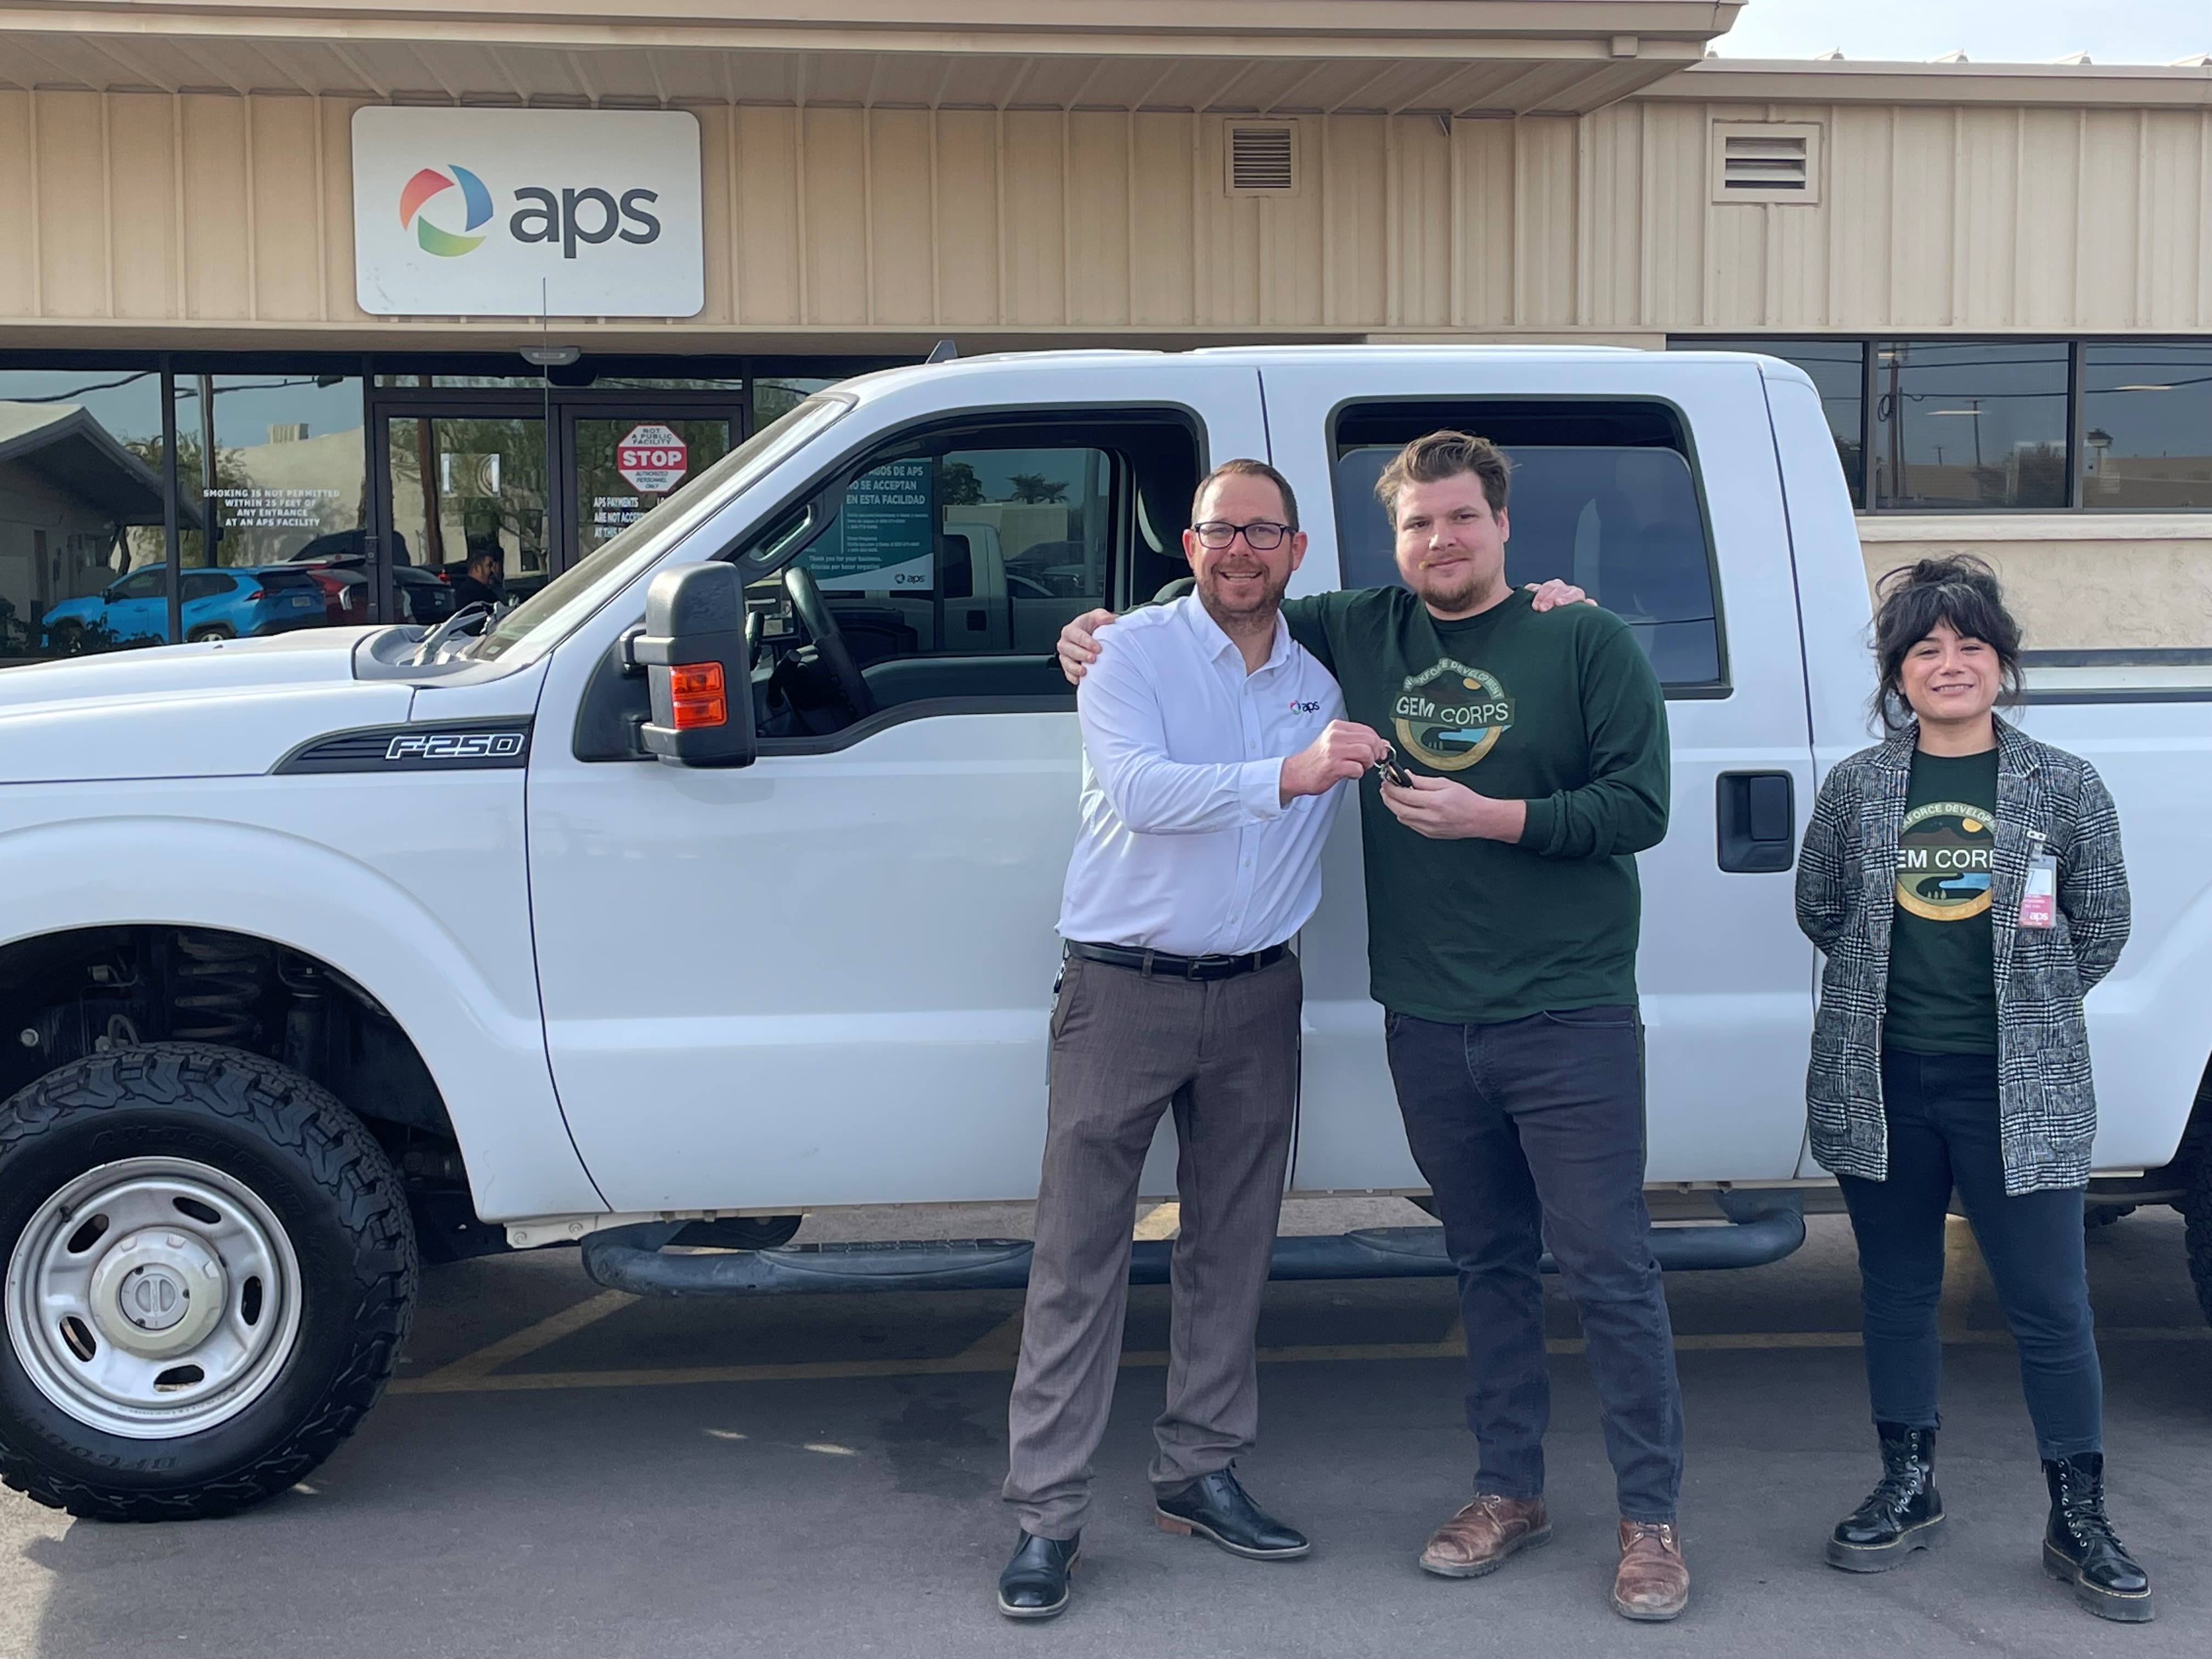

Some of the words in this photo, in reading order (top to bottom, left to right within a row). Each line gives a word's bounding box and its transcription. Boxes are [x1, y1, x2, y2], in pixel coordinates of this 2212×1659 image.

[510, 187, 661, 259] aps
[623, 450, 682, 466] STOP
[868, 466, 891, 476] AGOS
[893, 466, 905, 476] DE
[907, 466, 923, 476] APS
[861, 481, 871, 490] SE
[873, 481, 917, 490] ACCEPTAN
[594, 496, 606, 507] APS
[847, 495, 858, 504] EN
[860, 495, 881, 504] ESTA
[882, 495, 926, 504] FACILIDAD
[907, 575, 924, 584] aps
[1301, 701, 1320, 713] aps
[1396, 696, 1435, 718] GEM
[1441, 703, 1509, 724] CORPS
[385, 733, 525, 760] F-250
[1902, 804, 1942, 828] KFORCE
[1945, 804, 1995, 828] DEVELOP
[1896, 849, 1927, 868] EM
[1935, 849, 1993, 868] COR
[2030, 912, 2049, 922] aps
